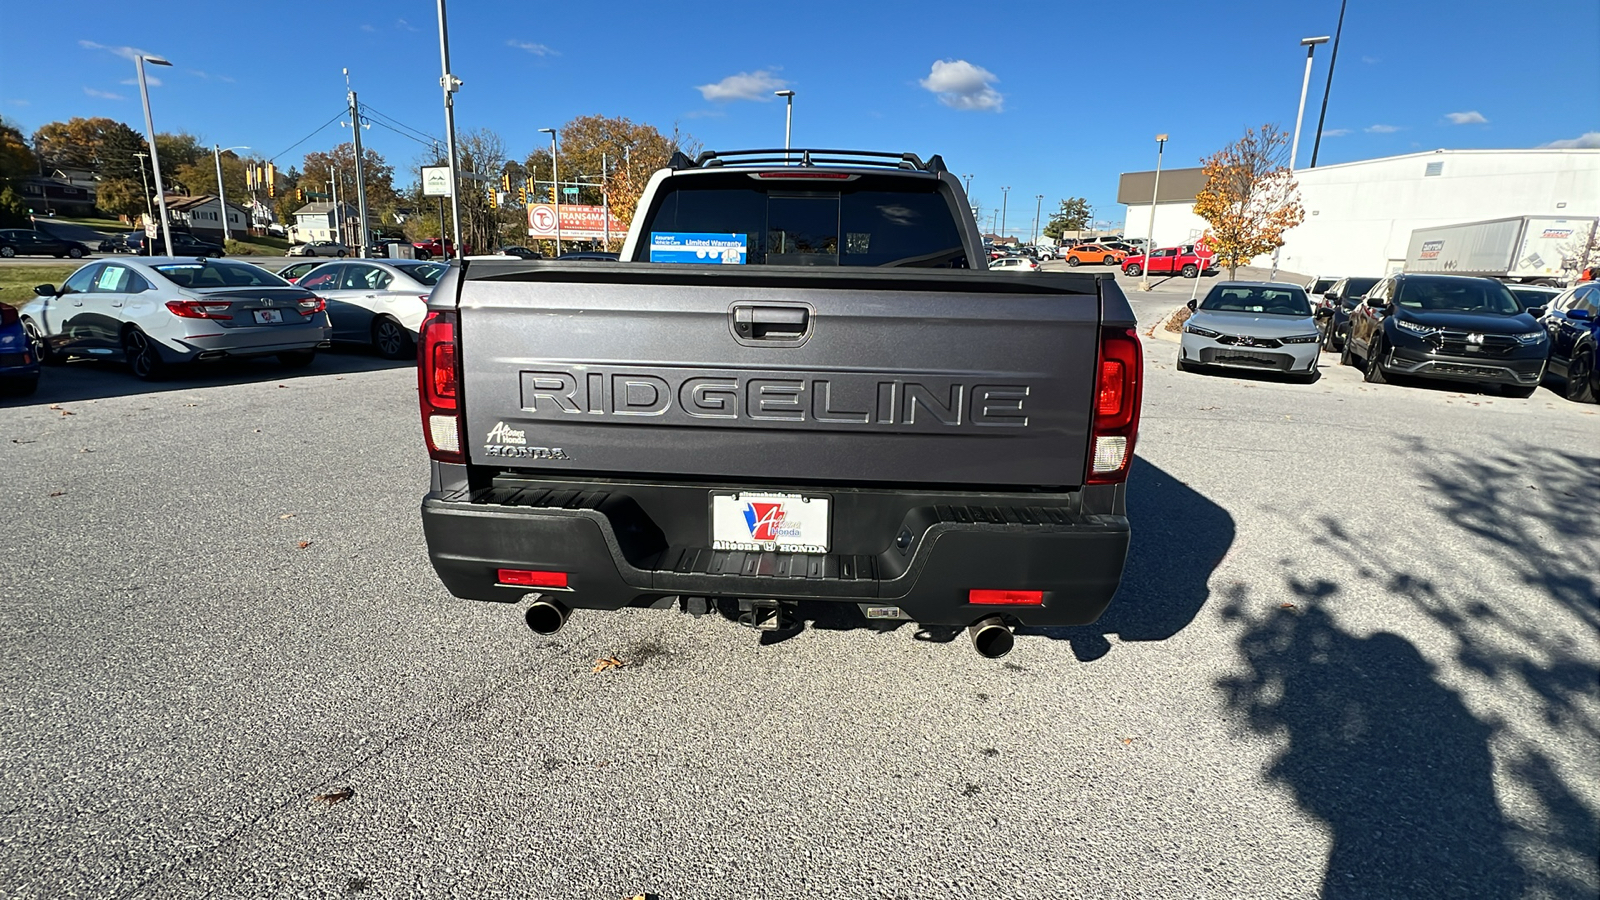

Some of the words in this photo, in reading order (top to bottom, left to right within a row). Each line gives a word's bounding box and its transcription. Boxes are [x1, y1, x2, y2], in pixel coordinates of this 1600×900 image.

[685, 239, 710, 247] Limited
[711, 240, 742, 248] Warranty
[519, 369, 1031, 428] RIDGELINE
[484, 445, 570, 460] HONDA
[771, 527, 801, 537] Honda
[713, 540, 760, 551] Altoona
[779, 543, 828, 554] HONDA
